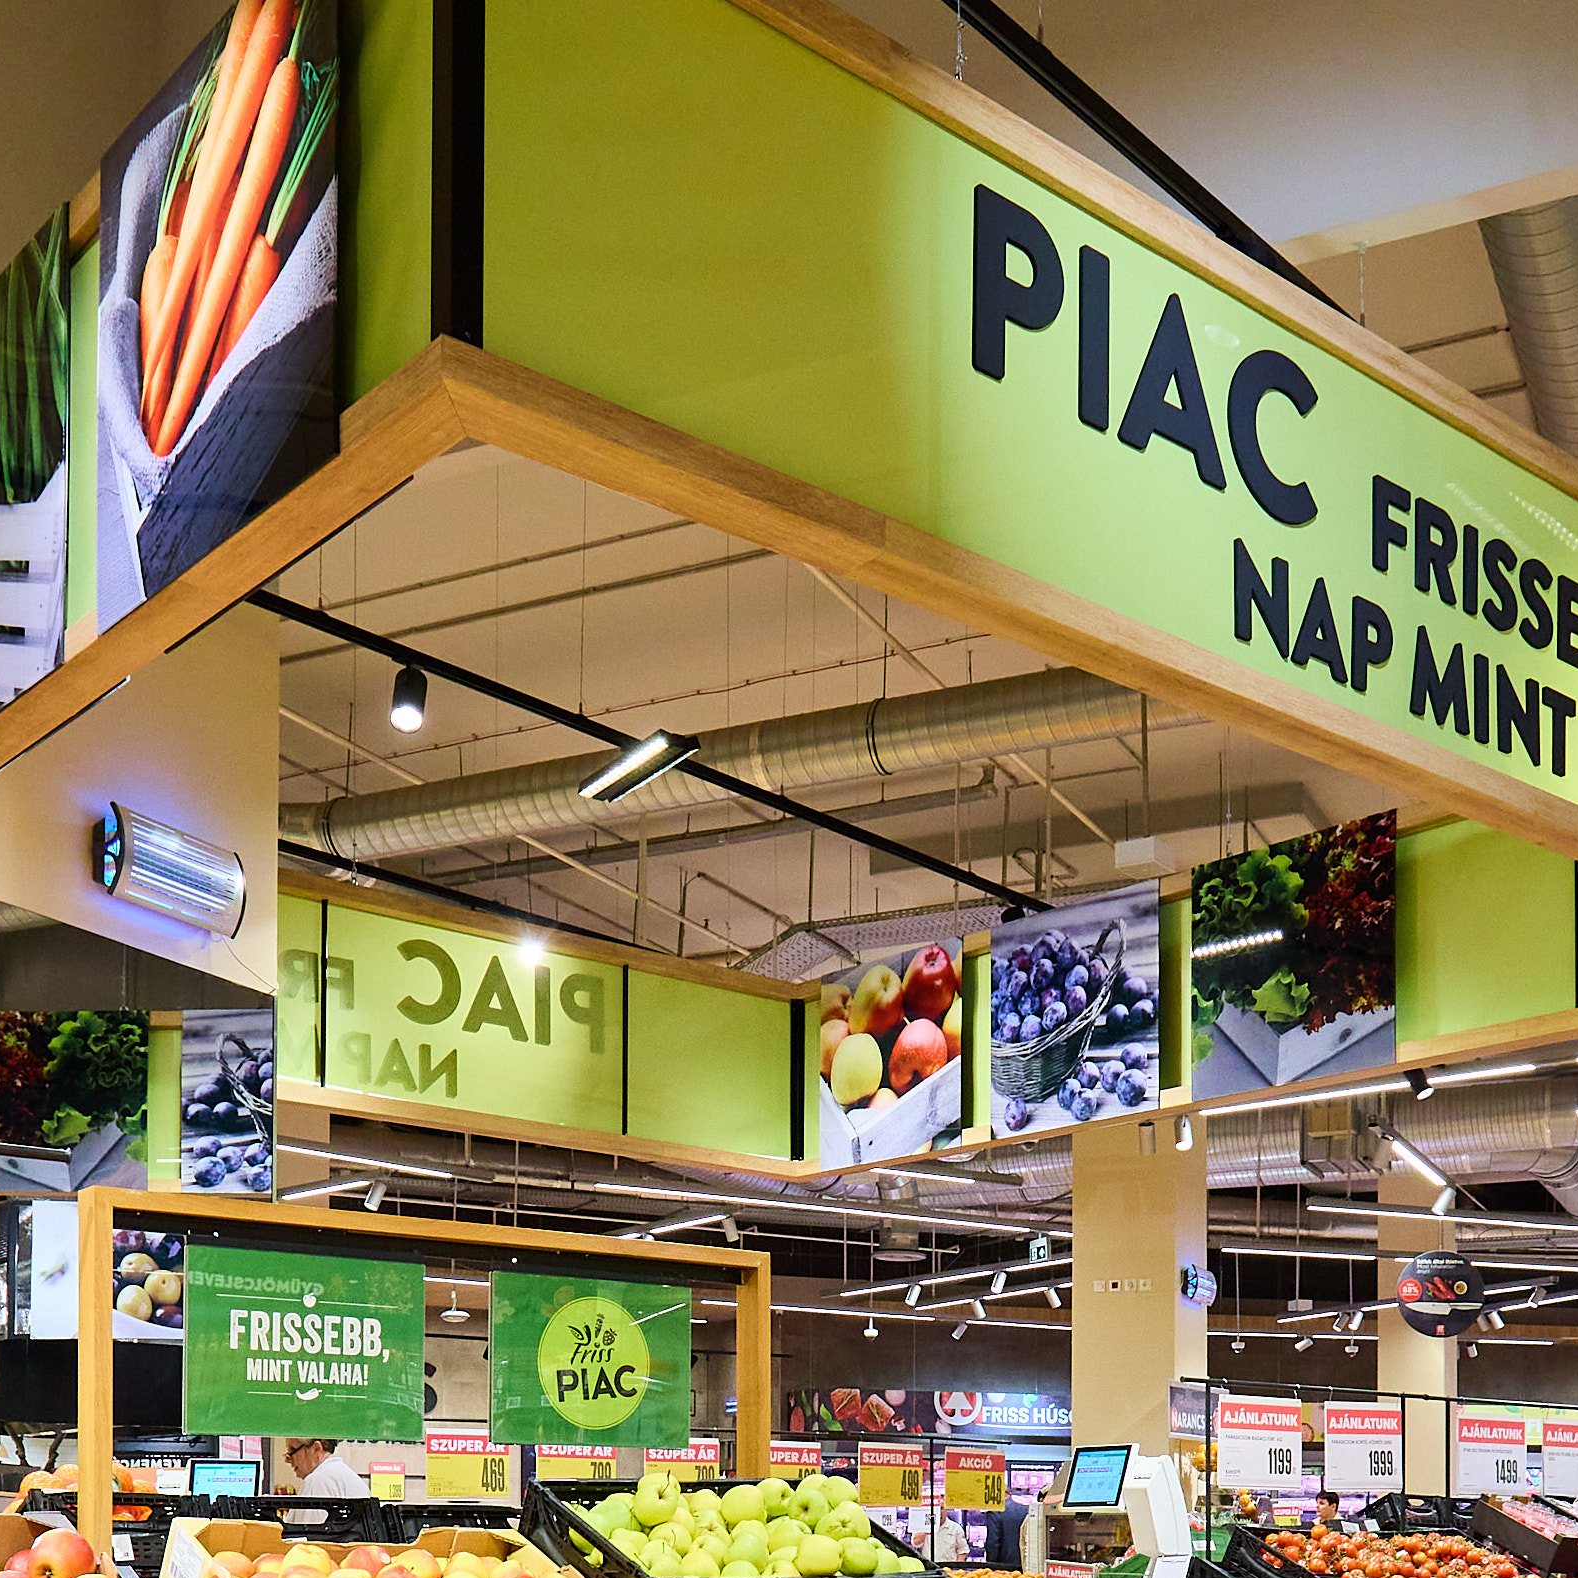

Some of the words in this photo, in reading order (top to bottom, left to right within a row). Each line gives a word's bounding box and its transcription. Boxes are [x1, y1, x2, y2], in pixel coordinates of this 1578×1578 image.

[972, 184, 1318, 526] PIAC
[1234, 538, 1393, 692] NAP
[1410, 626, 1576, 778] MINT
[229, 1308, 390, 1363] FRISSEBB,
[246, 1358, 293, 1383] MINT
[297, 1360, 369, 1386] VALAHA!
[557, 1365, 638, 1402] PIAC
[982, 1406, 1030, 1424] FRISS
[1171, 1407, 1213, 1430] NARANCS
[1223, 1407, 1298, 1428] AJÁNLATUNK
[1329, 1413, 1399, 1431] AJÁNLATUNK
[1461, 1423, 1523, 1440] AJÁNLATUNK
[430, 1438, 484, 1453] SZUPER
[541, 1443, 592, 1457] SZUPER
[648, 1447, 695, 1460] SZUPER
[698, 1447, 716, 1461] ÁR
[800, 1448, 818, 1464] ÁR
[862, 1451, 904, 1466] SZUPER
[904, 1450, 920, 1466] ÁR
[959, 1455, 993, 1470] AKCIÓ
[1268, 1447, 1292, 1475] 1199
[1369, 1450, 1394, 1476] 1999
[481, 1457, 505, 1492] 469
[1495, 1459, 1518, 1484] 1499
